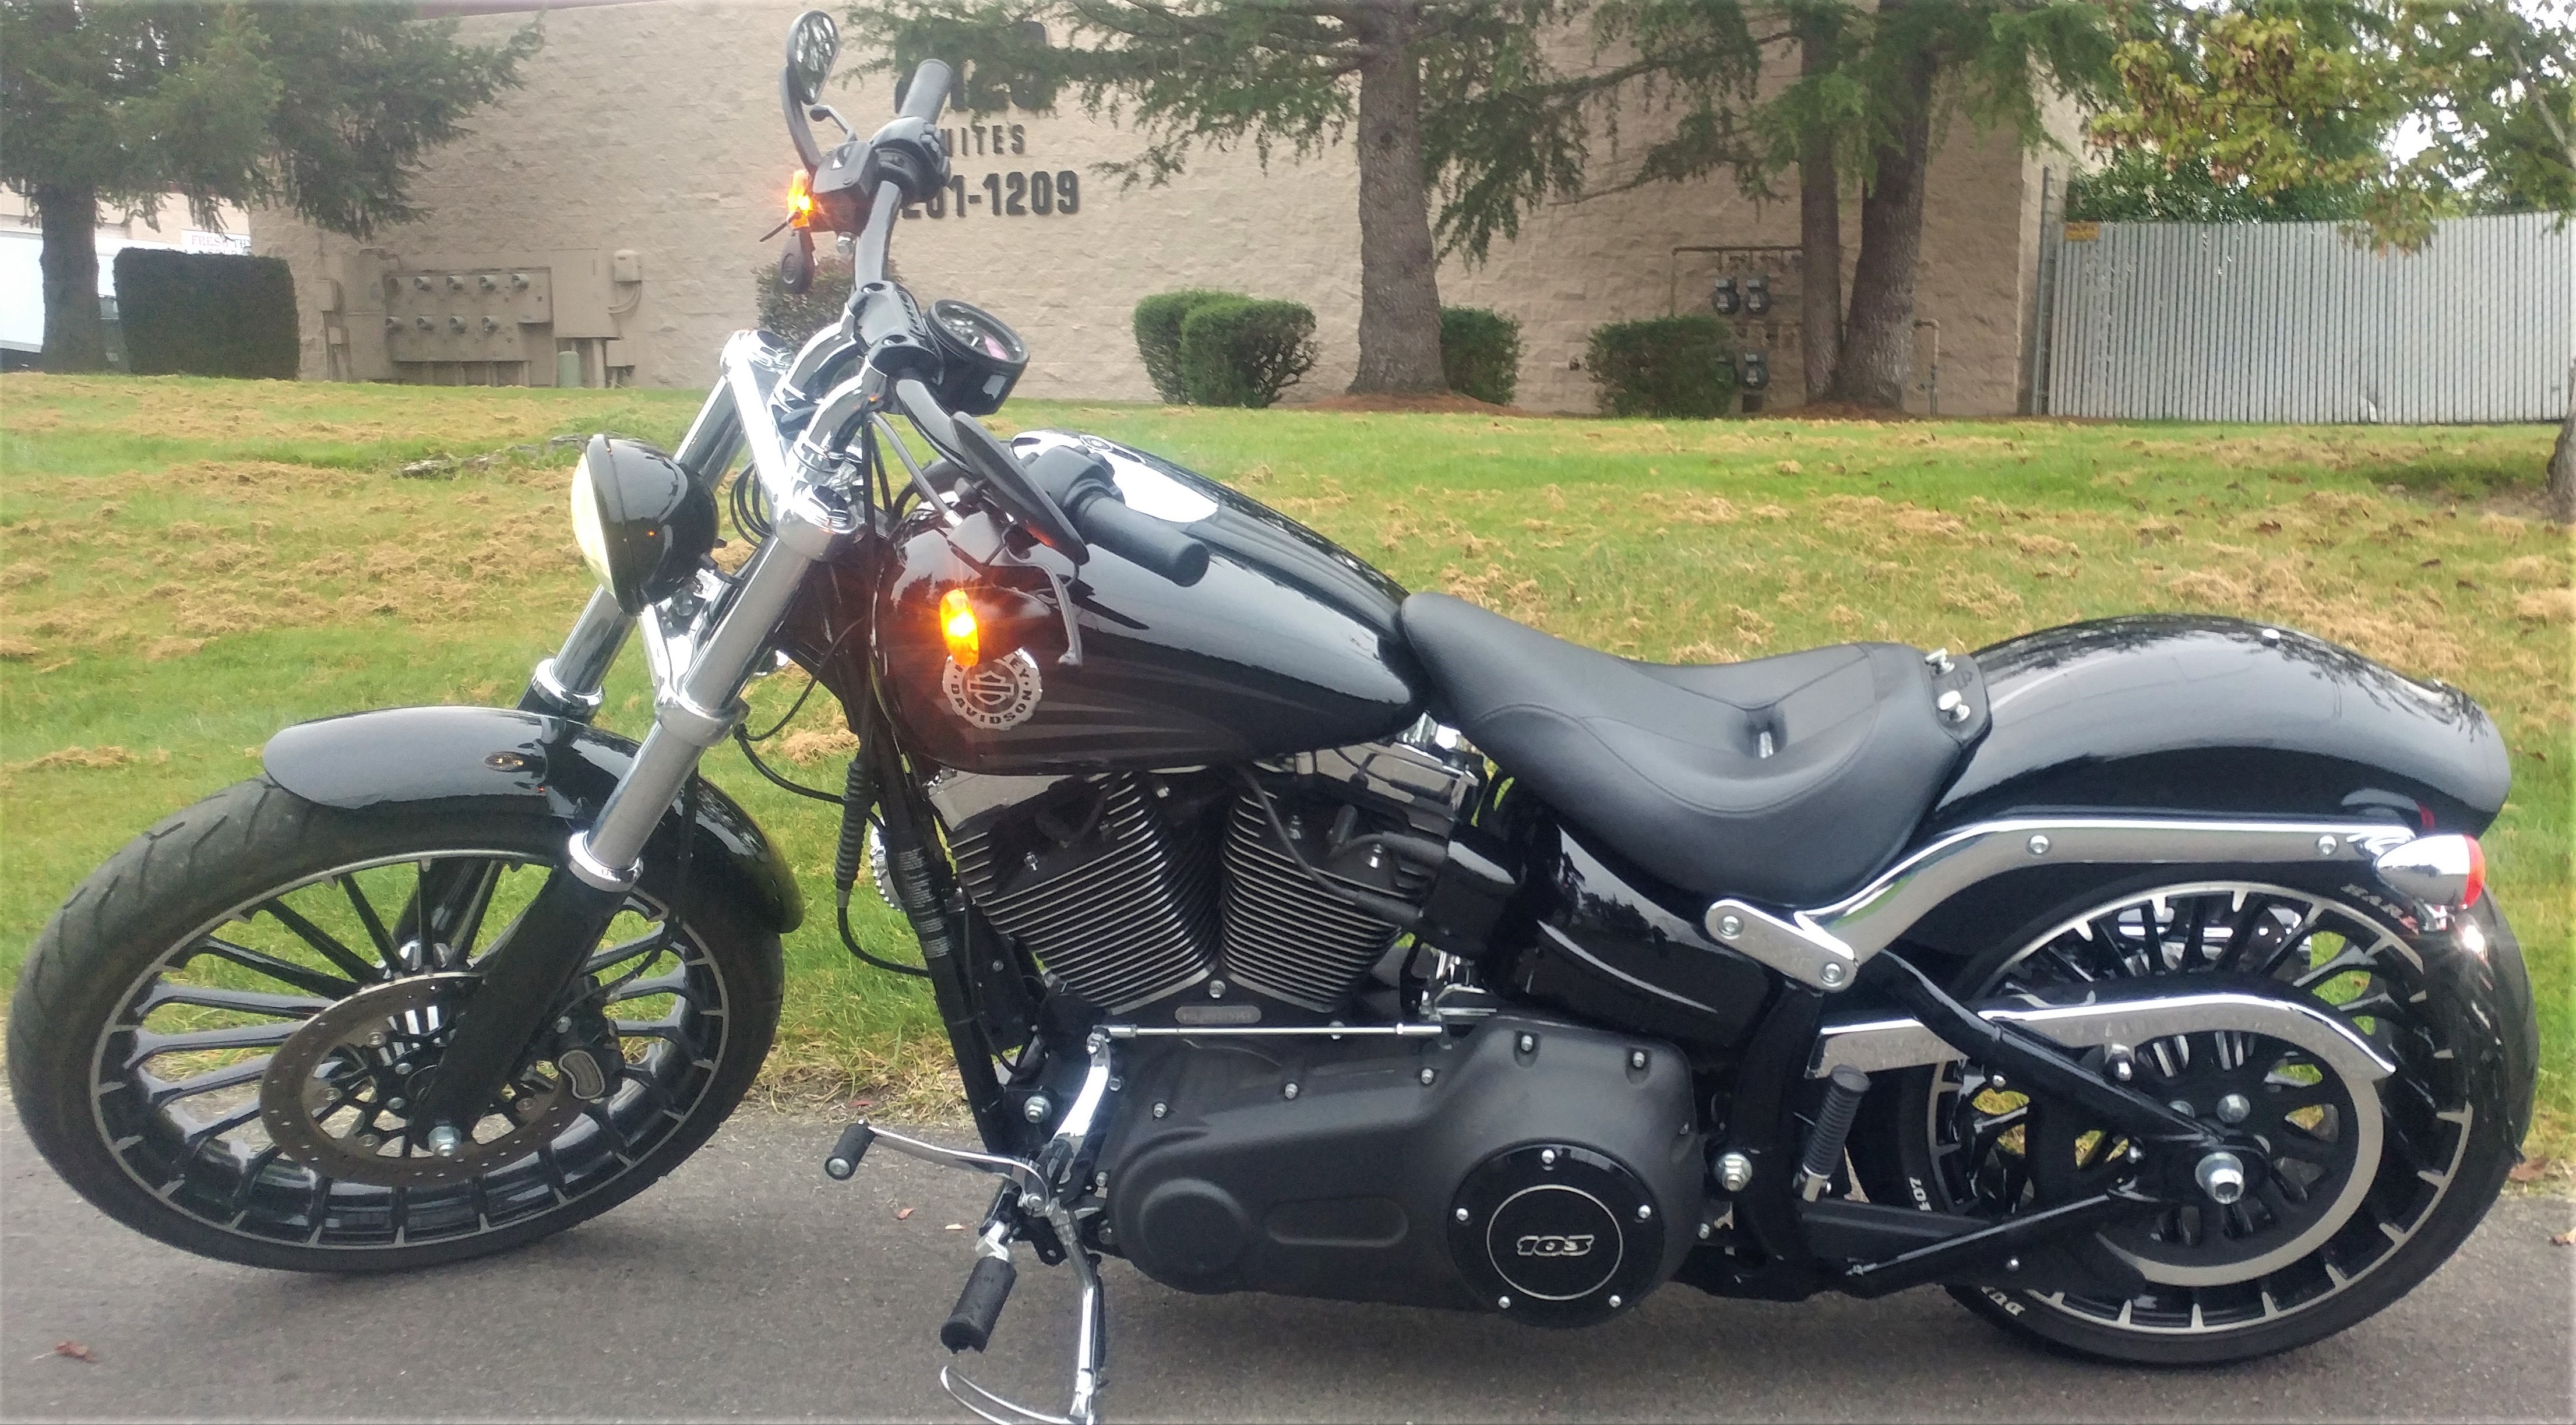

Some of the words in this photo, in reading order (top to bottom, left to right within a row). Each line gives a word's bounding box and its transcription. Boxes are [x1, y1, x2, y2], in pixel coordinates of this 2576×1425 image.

[939, 124, 1026, 158] UITES
[191, 235, 228, 247] FRESH
[951, 683, 1032, 724] DAVIDSON
[1517, 1234, 1595, 1256] 103
